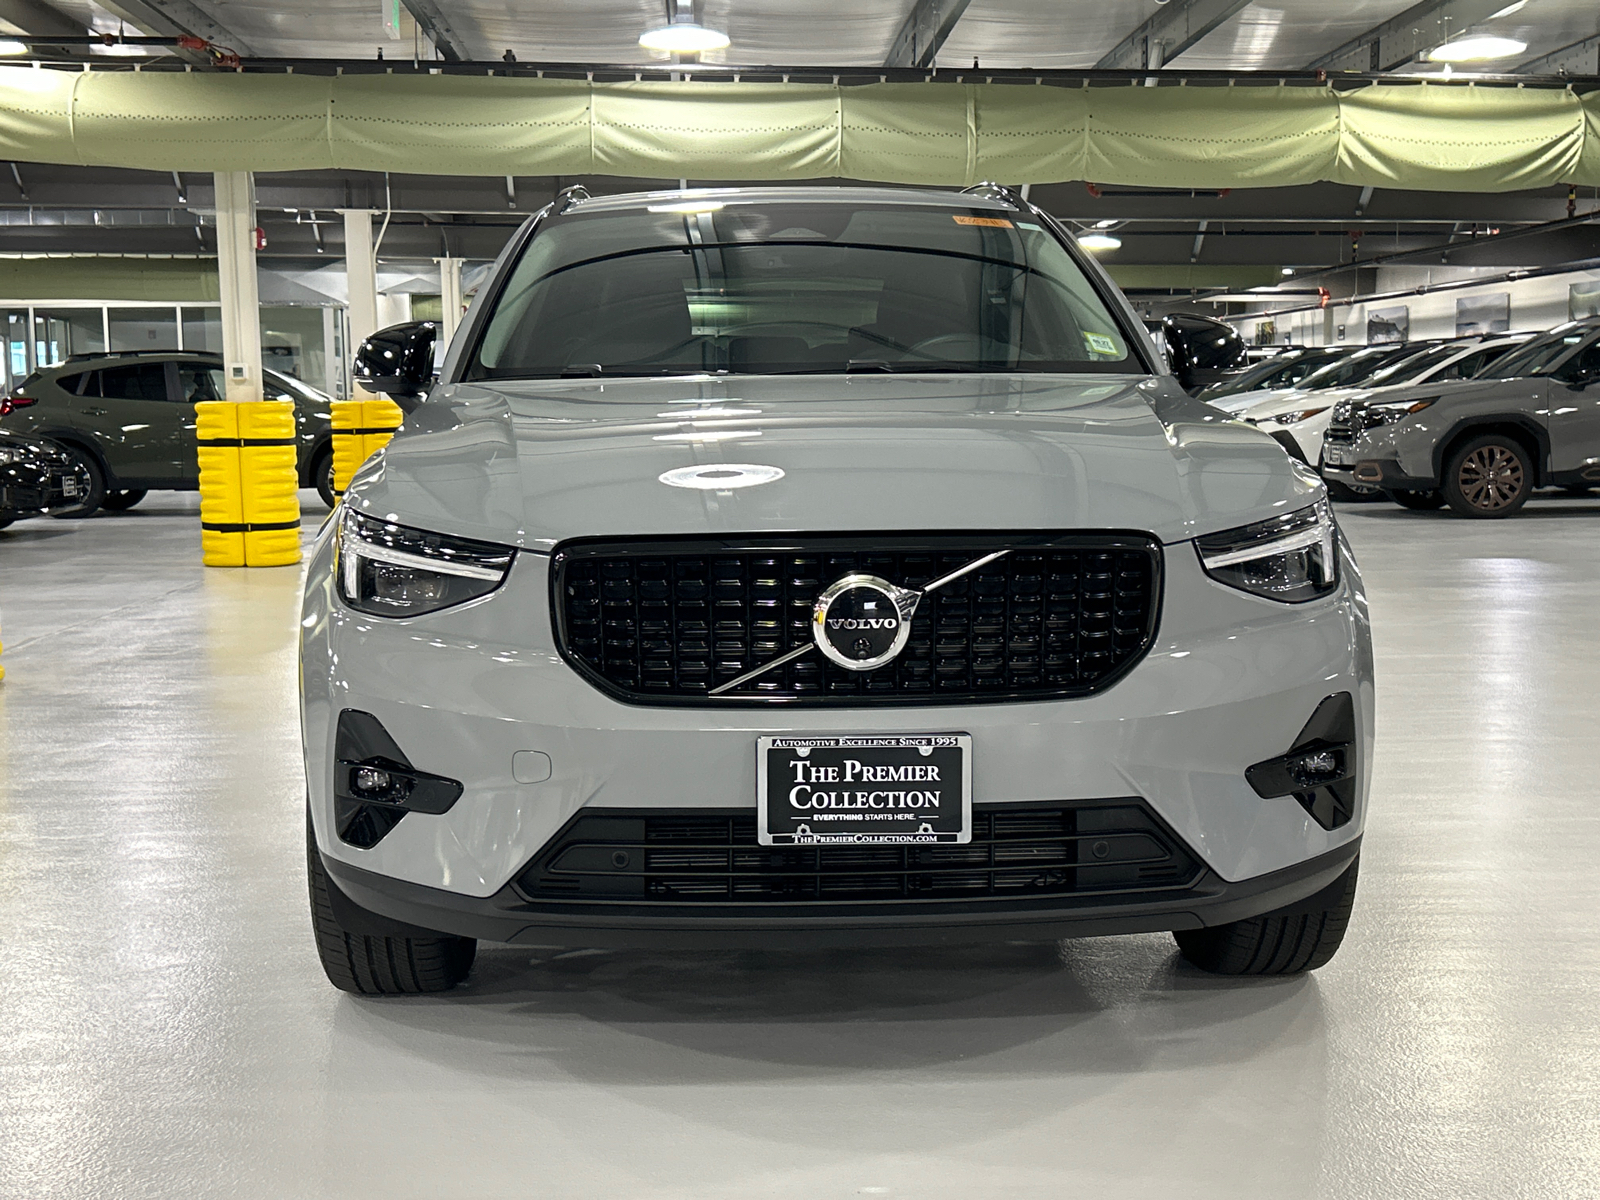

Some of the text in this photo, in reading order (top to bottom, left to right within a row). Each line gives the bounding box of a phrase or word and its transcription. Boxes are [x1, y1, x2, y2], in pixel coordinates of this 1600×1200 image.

[827, 618, 897, 629] VOLVO
[774, 737, 957, 747] AUTOMOTIVE EXCELLENCE SINCE 1995
[789, 760, 941, 783] THE PREMIER
[789, 784, 941, 809] COLLECTION
[813, 813, 863, 821] EVERYTHING
[864, 813, 893, 821] STARTS
